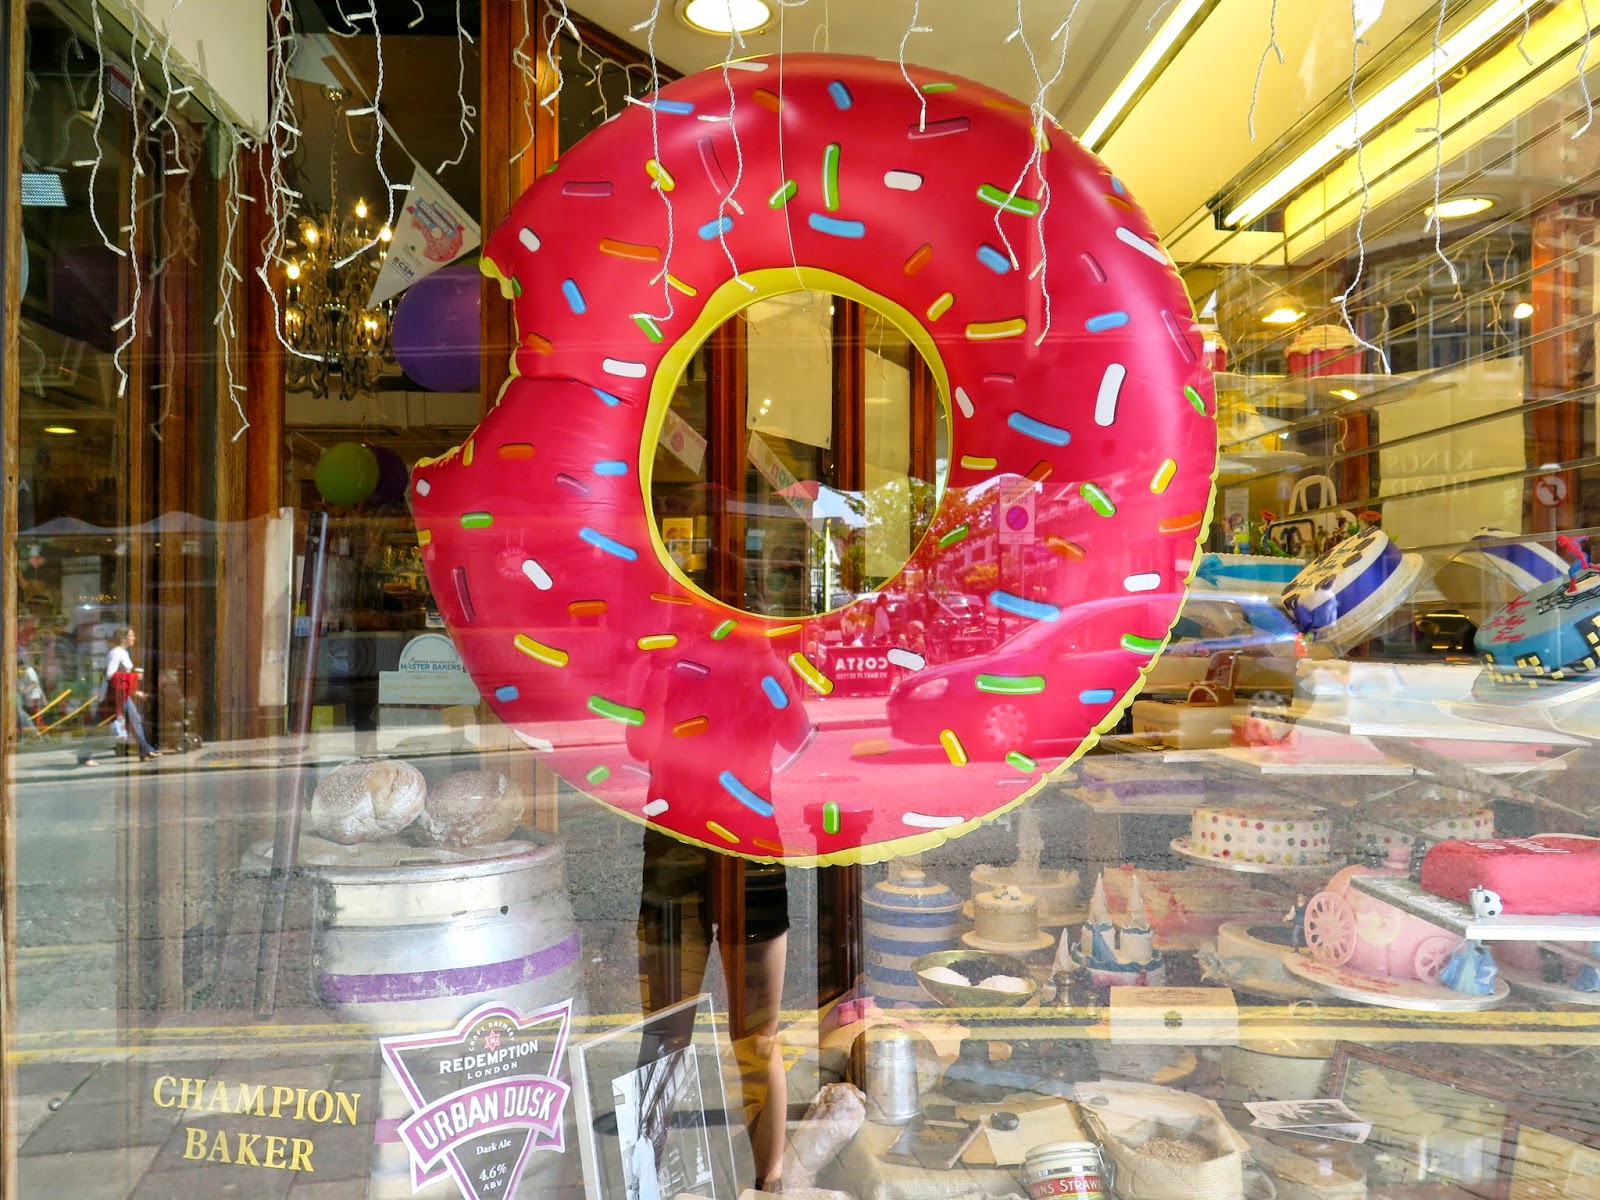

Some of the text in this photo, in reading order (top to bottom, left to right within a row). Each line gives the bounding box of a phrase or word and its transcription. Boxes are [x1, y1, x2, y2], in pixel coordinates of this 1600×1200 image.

[398, 261, 415, 278] CSM
[400, 663, 461, 671] MASTER BAKERS
[468, 1021, 516, 1052] CRAFT BREWERY
[439, 1039, 539, 1075] REDEMPTION
[467, 1061, 519, 1080] LONDON
[153, 1074, 361, 1126] CHAMPION
[415, 1085, 557, 1151] URBAN DUSK
[183, 1127, 315, 1172] BAKER
[476, 1138, 512, 1156] Dark Ale
[478, 1163, 507, 1182] 4.6%
[483, 1179, 503, 1192] ABV
